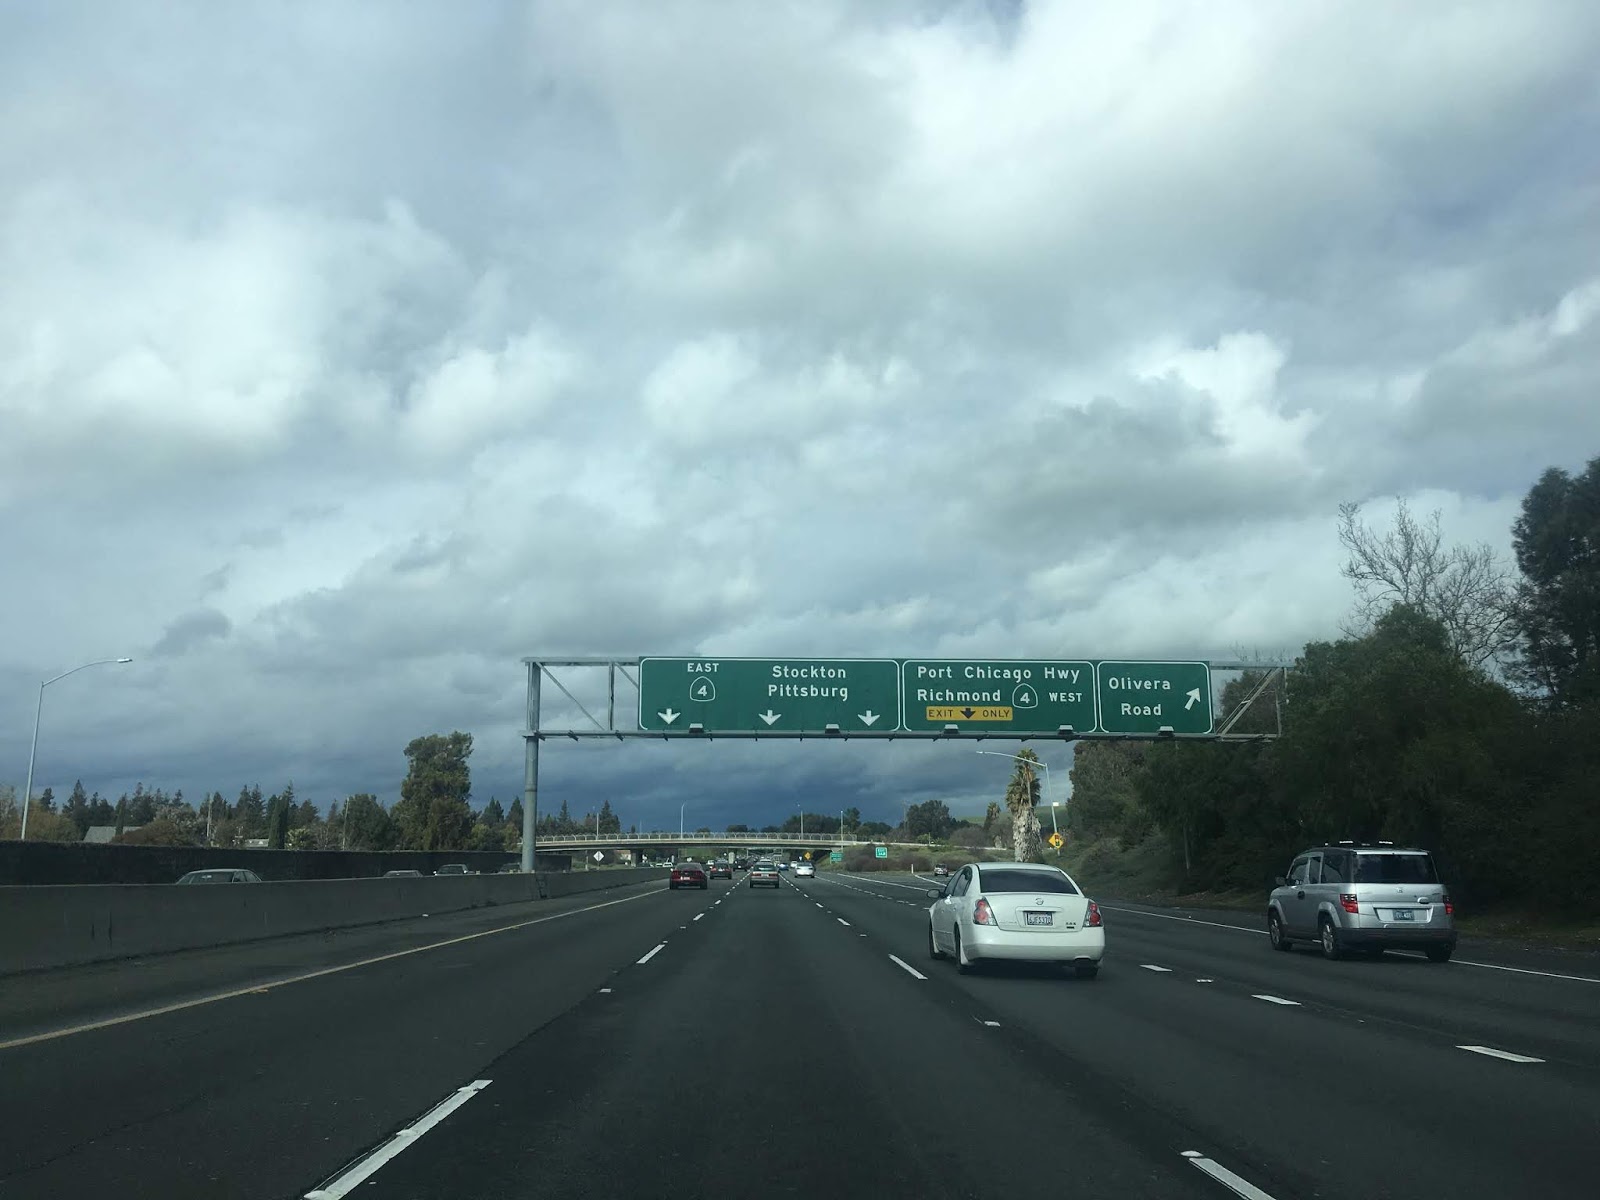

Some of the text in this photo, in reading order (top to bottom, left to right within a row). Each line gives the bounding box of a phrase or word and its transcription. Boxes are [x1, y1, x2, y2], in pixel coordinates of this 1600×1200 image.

[687, 663, 719, 673] EAST
[772, 665, 846, 678] Stockton
[917, 666, 1080, 683] Port Chicago Hwy
[1109, 677, 1171, 690] Olivera
[697, 685, 707, 697] 4
[768, 684, 848, 701] Pittsburg
[917, 689, 1001, 702] Richmond
[1019, 691, 1030, 703] 4
[1049, 692, 1082, 702] WEST
[928, 708, 1010, 718] EXIT ONLY
[1121, 703, 1162, 716] Road
